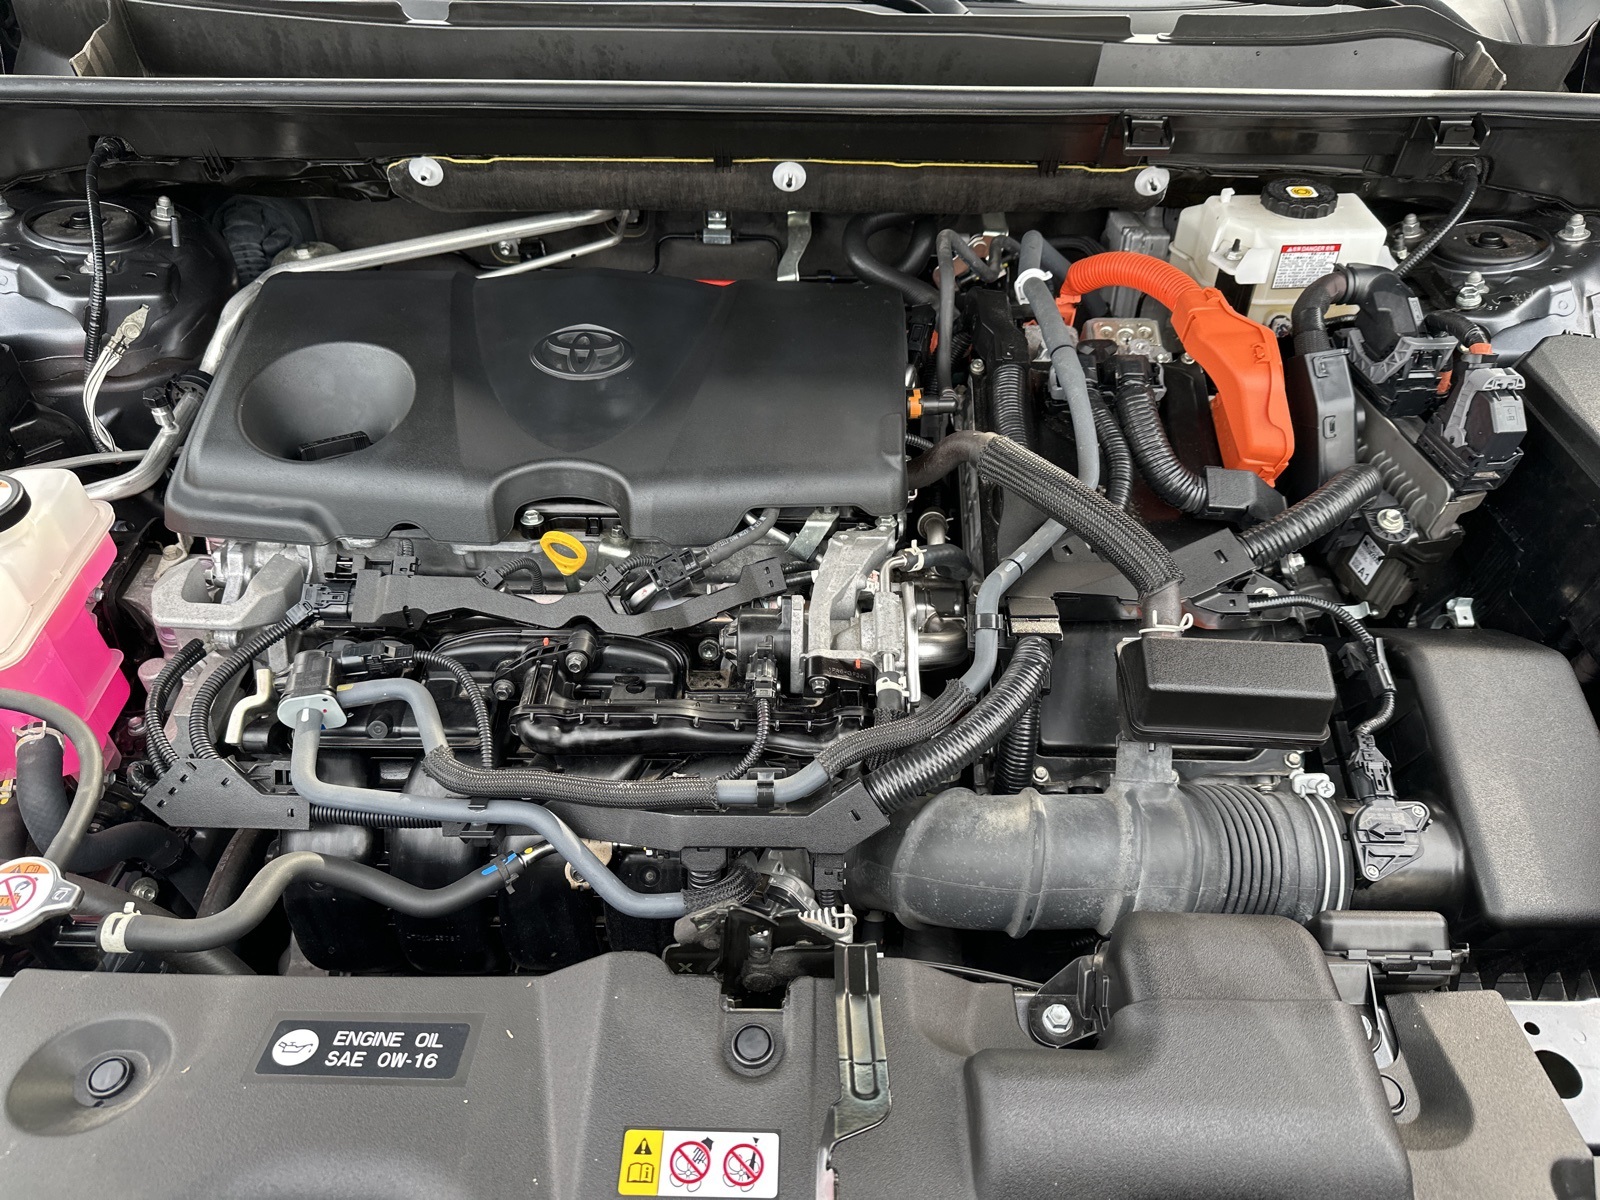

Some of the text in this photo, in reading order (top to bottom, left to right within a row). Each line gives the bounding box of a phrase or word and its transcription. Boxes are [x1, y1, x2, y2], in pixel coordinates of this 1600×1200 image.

[332, 1030, 444, 1049] ENGINE OIL
[324, 1050, 439, 1070] SAE 0W-16
